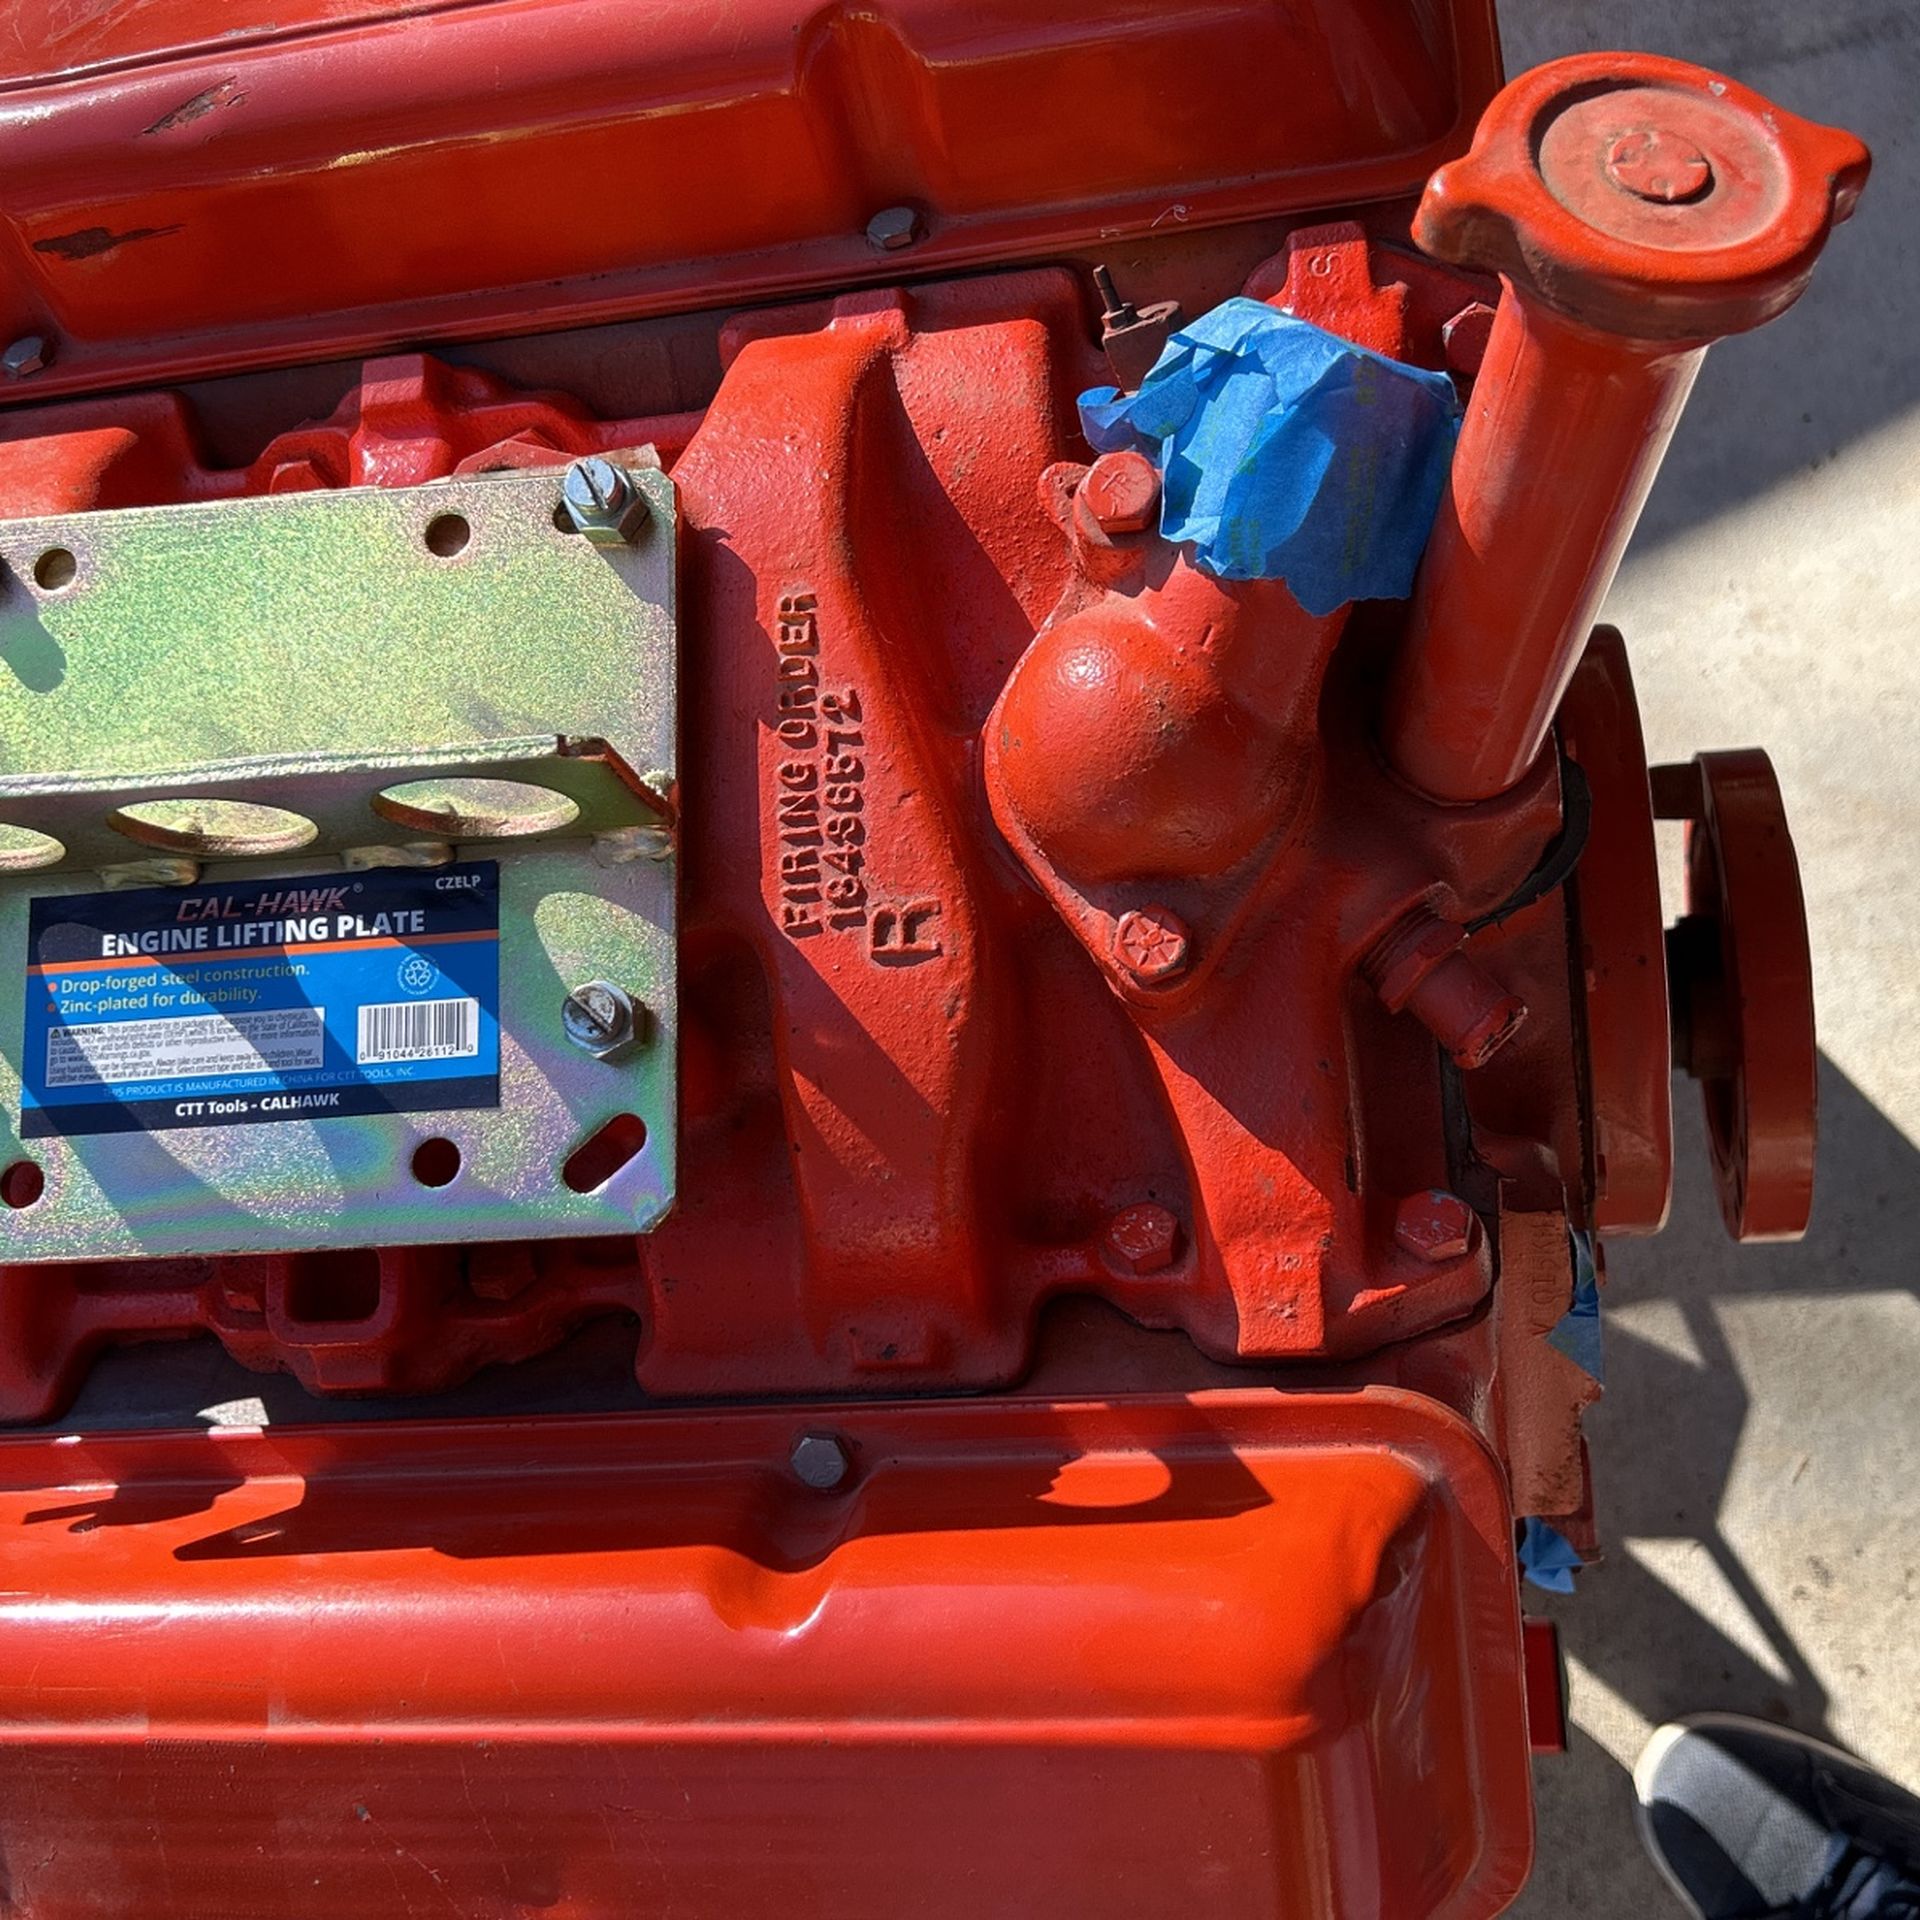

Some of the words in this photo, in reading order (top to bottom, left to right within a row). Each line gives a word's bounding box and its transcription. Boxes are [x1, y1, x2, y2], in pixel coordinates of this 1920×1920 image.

[777, 592, 820, 751] ORDER
[779, 760, 824, 939] FIRING
[434, 874, 482, 890] CZELP
[176, 886, 350, 922] CAL-HAWK
[102, 927, 208, 957] ENGINE
[217, 916, 328, 947] LIFTING
[337, 910, 425, 938] PLATE
[870, 900, 944, 968] R
[61, 972, 157, 994] Drop-forged
[161, 969, 200, 986] steel
[204, 963, 310, 982] construction.
[60, 995, 148, 1014] Zinc-plated
[153, 993, 176, 1007] for
[180, 985, 262, 1006] durability.
[359, 1051, 366, 1061] 0
[126, 1083, 172, 1097] PRODUCT
[174, 1081, 184, 1093] IS
[185, 1076, 267, 1092] MANUFACTURED
[269, 1075, 280, 1085] IN
[282, 1074, 314, 1085] CHINA
[315, 1072, 335, 1082] FOR
[175, 1102, 203, 1117] CTT
[208, 1099, 248, 1114] Tools
[261, 1093, 340, 1111] CALHAWK
